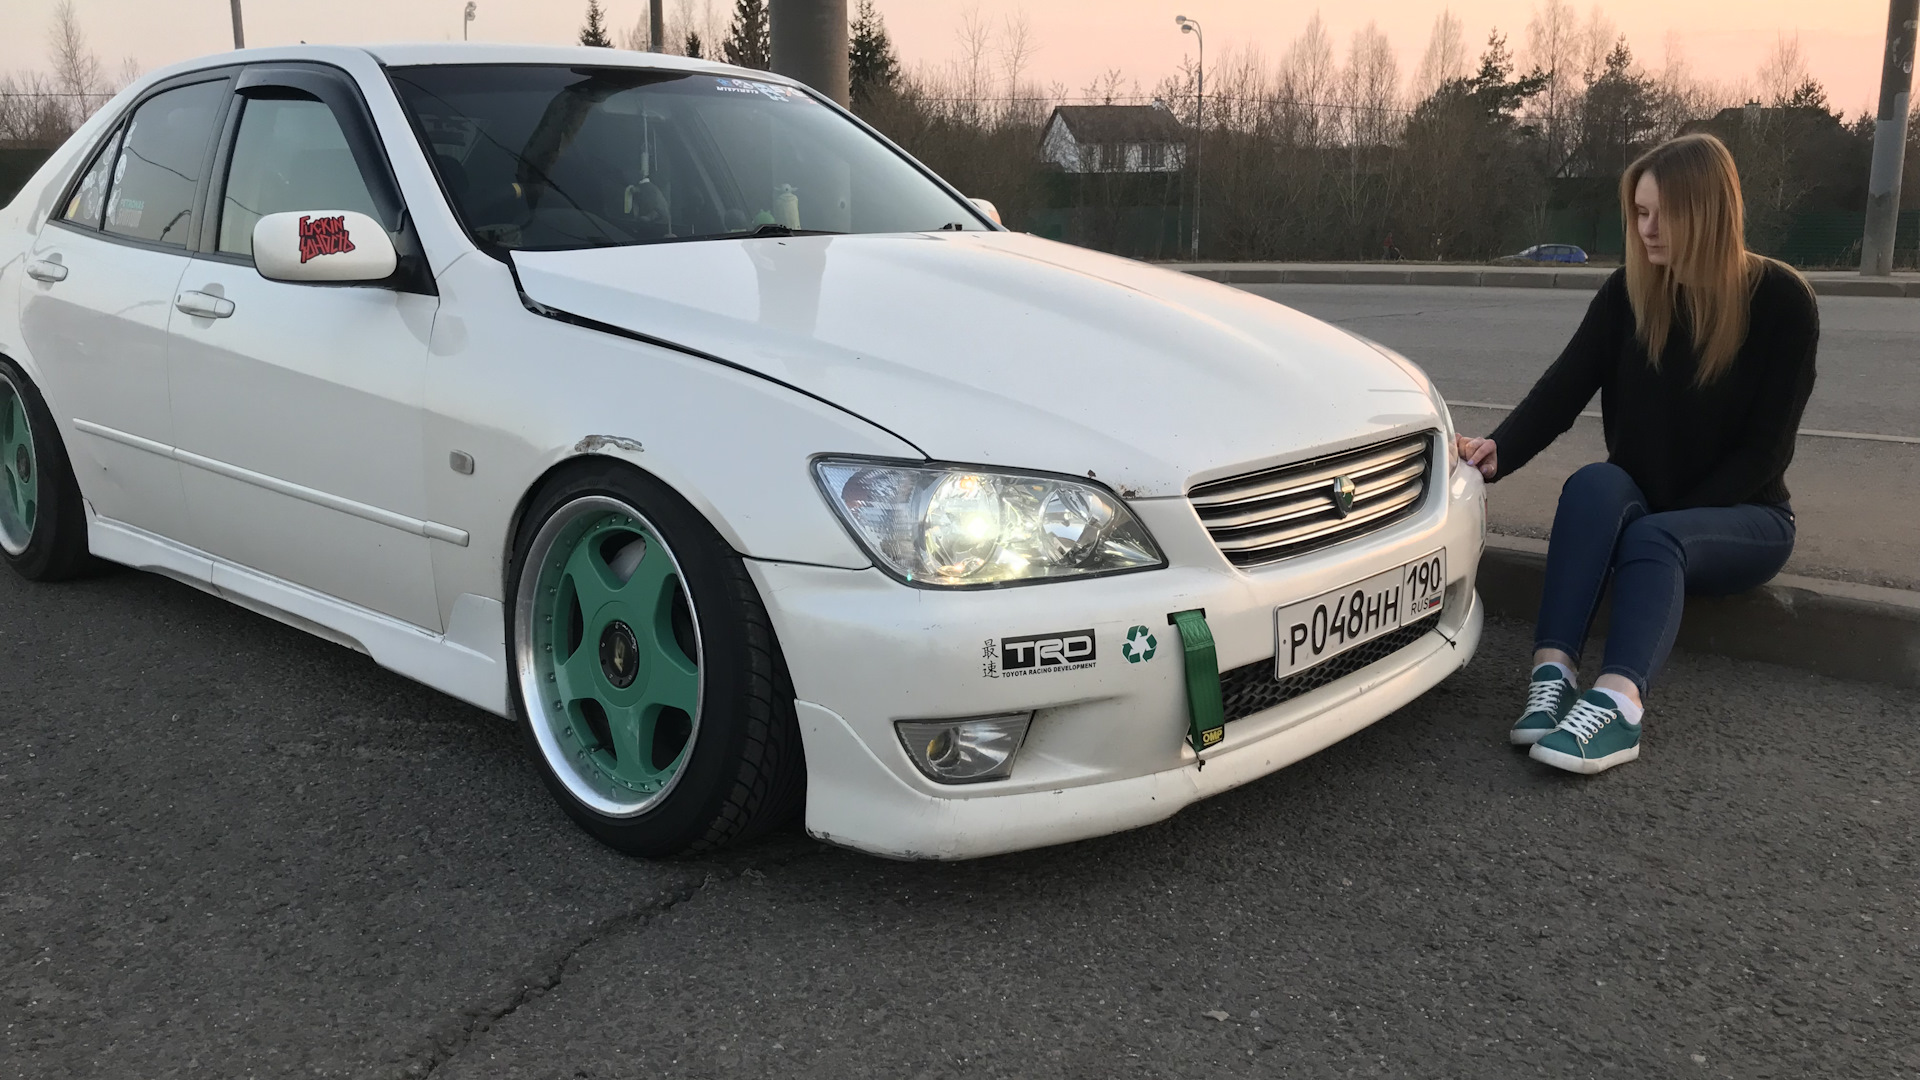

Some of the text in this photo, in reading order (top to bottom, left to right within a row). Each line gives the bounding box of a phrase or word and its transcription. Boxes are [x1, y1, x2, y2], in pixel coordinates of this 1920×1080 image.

[1407, 557, 1440, 601] 190
[1410, 597, 1429, 616] RUS
[982, 639, 999, 678] 最速
[1005, 635, 1093, 667] TRD
[1002, 662, 1096, 678] TOYOTA RACING DEVELOPMENT
[1203, 730, 1223, 743] OMP
